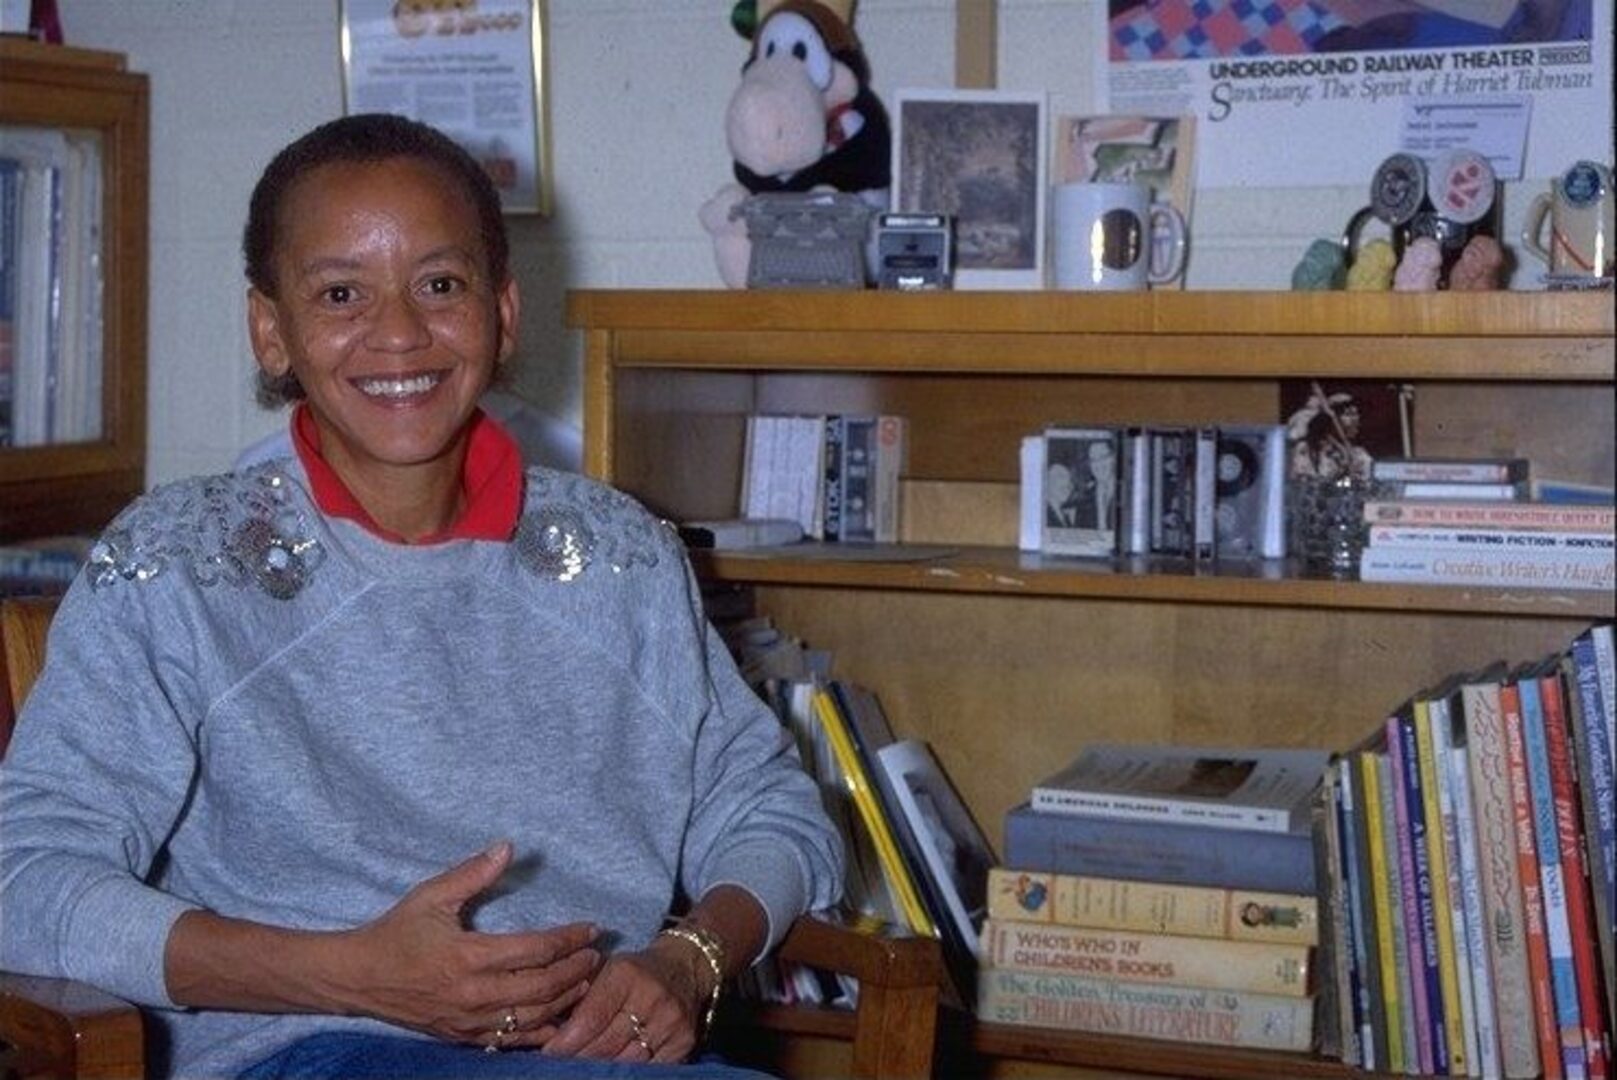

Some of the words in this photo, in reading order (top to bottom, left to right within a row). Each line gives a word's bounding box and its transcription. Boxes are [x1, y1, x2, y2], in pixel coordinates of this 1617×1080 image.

[1210, 58, 1358, 80] UNDERGROUND
[1364, 52, 1446, 73] RAILWAY
[1452, 50, 1534, 70] THEATER
[1320, 78, 1354, 100] The
[1360, 75, 1412, 103] Spirit
[1417, 74, 1437, 97] of
[1442, 70, 1510, 95] Harriet
[1513, 68, 1593, 91] Tubman
[1457, 534, 1504, 544] WRITING
[1507, 535, 1556, 546] FICTION
[1432, 559, 1493, 577] Creative
[1015, 931, 1071, 950] WHO'S
[1074, 935, 1117, 953] WHO
[1119, 939, 1141, 956] IN
[1117, 959, 1176, 978] BOOKS
[1000, 974, 1029, 994] The
[1035, 977, 1099, 999] Golden
[1105, 983, 1182, 1007] Treasury
[1190, 991, 1208, 1008] of
